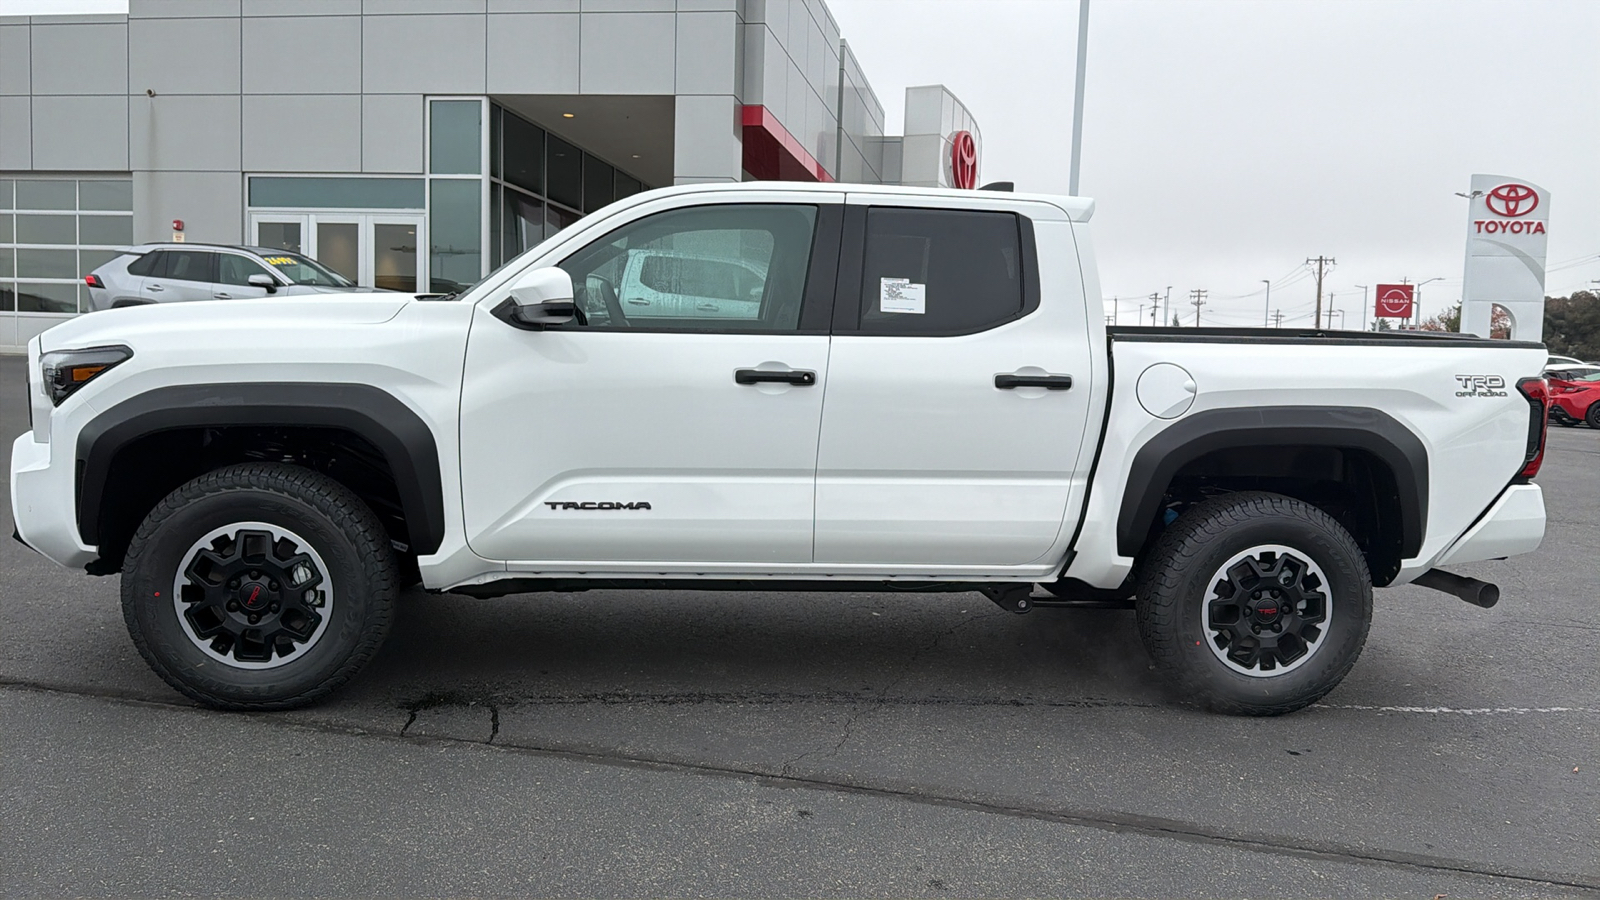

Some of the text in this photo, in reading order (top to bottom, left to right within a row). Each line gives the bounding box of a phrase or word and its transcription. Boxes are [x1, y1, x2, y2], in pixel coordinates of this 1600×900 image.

[1474, 220, 1546, 235] TOYOTA
[1455, 374, 1506, 392] TRD
[543, 501, 652, 511] TACOMA
[247, 585, 261, 605] TRD
